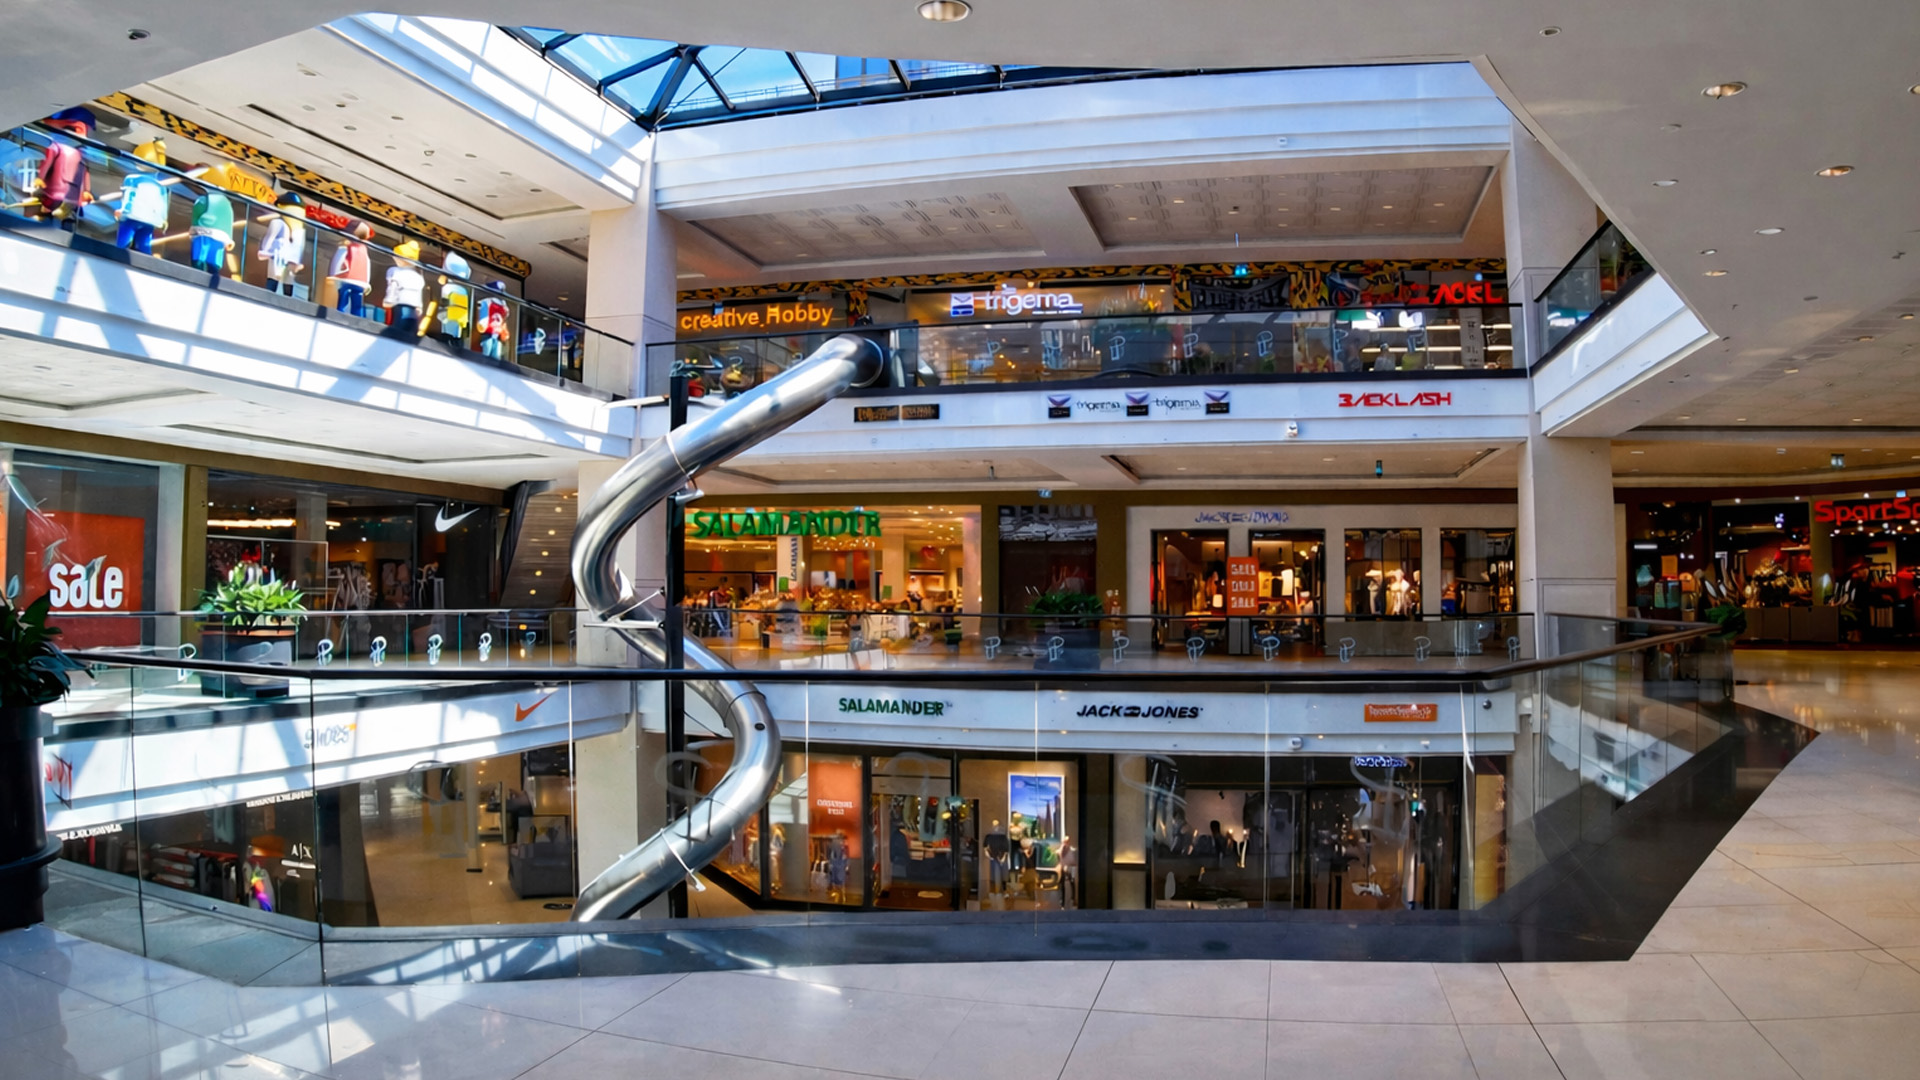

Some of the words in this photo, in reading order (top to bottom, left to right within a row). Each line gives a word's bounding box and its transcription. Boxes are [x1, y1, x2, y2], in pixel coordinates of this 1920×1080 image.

[680, 307, 760, 331] creative
[776, 303, 833, 326] Hobby
[50, 563, 124, 608] sale
[839, 698, 944, 716] SALAMANDER
[1077, 705, 1123, 718] JACK
[1141, 706, 1199, 719] JONES
